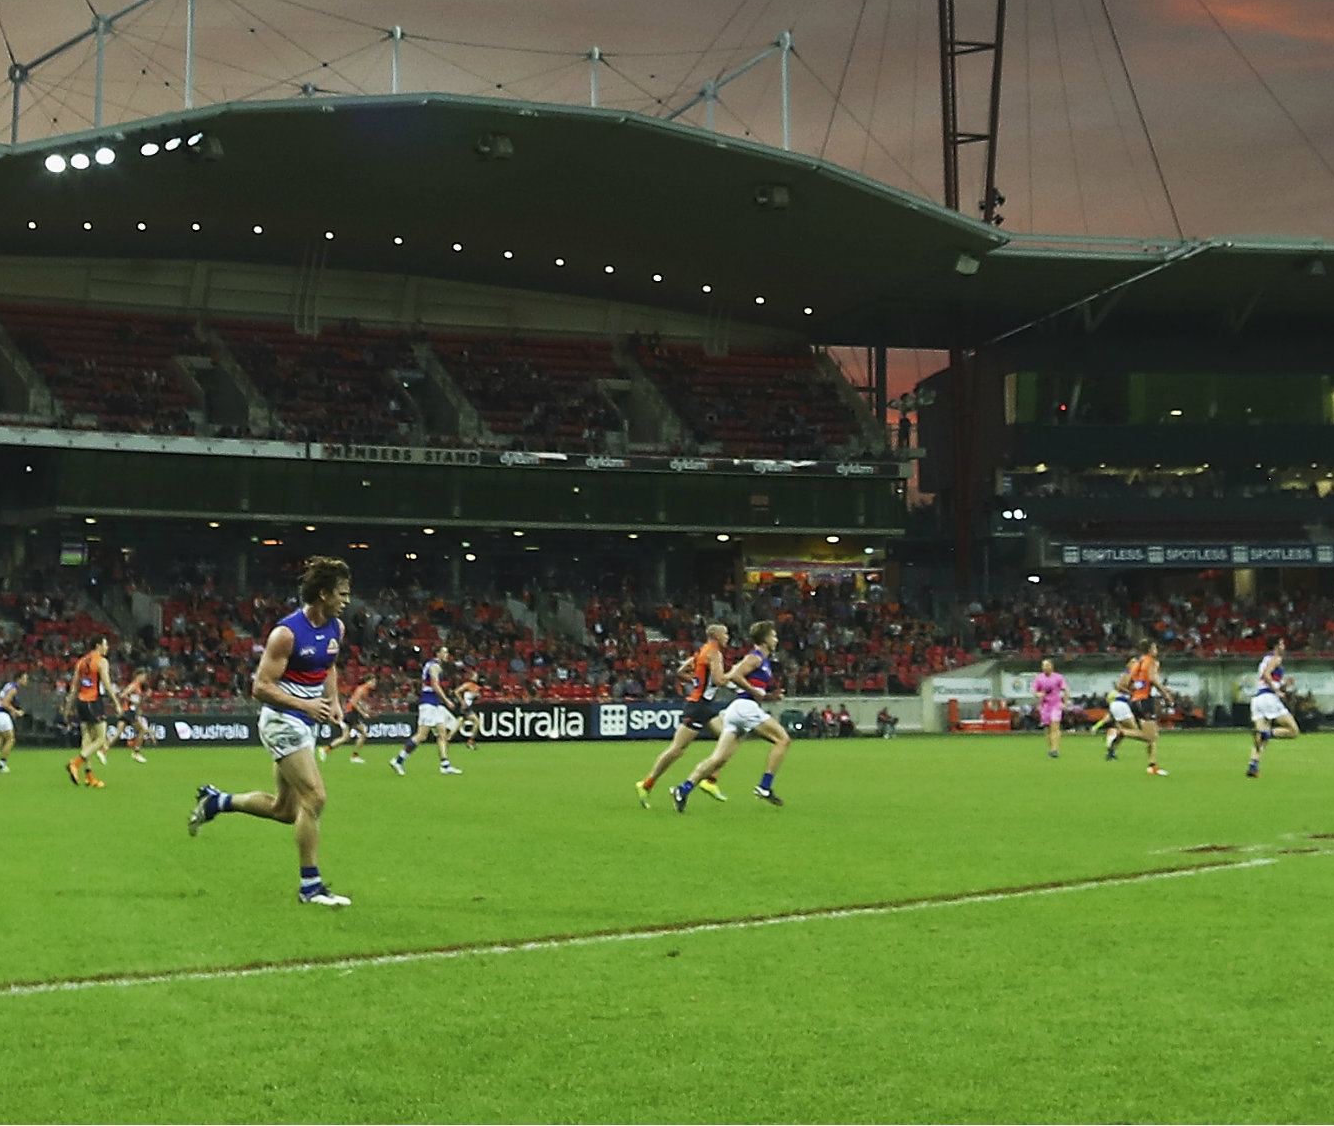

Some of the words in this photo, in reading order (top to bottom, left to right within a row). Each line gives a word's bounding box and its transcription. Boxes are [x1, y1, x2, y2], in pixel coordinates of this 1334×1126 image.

[327, 444, 413, 462] MEMBERS
[424, 449, 481, 465] STAND
[1166, 548, 1228, 561] SPOTLESS
[1250, 548, 1312, 561] SPOTLESS
[191, 722, 250, 740] australia
